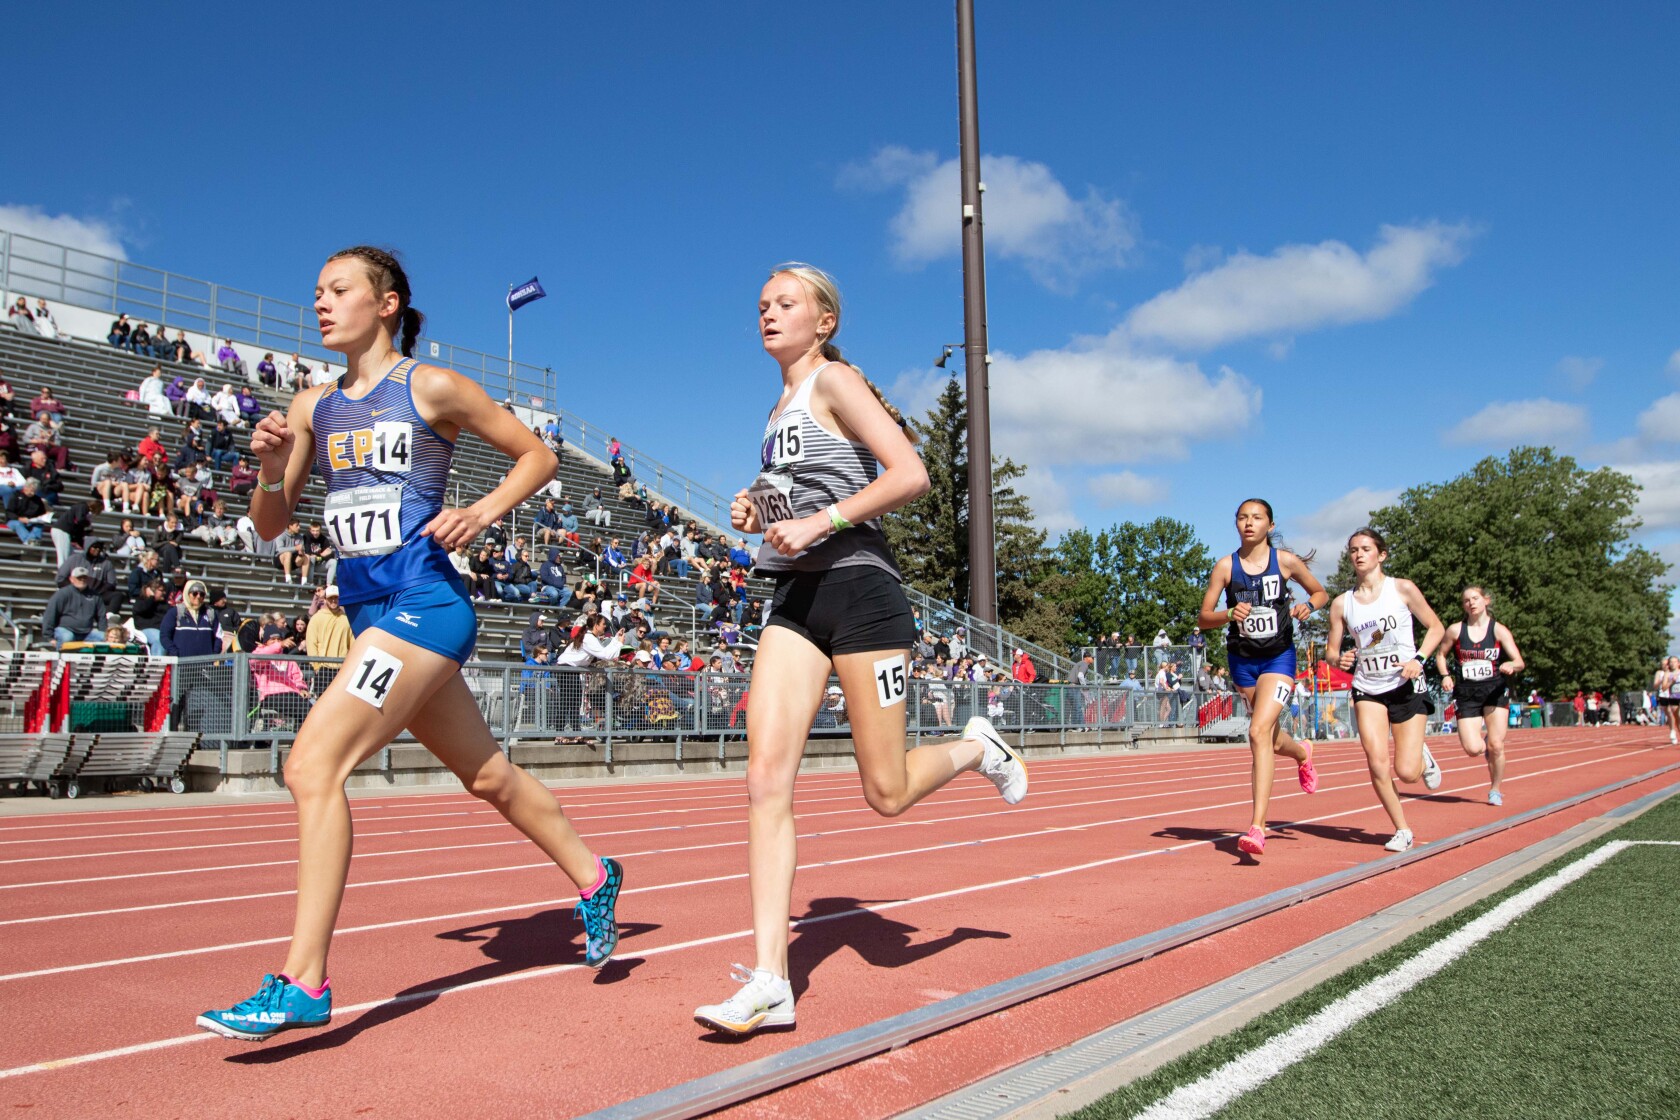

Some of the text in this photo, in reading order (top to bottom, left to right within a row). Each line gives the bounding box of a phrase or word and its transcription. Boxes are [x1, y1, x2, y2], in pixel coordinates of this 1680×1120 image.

[432, 345, 437, 353] G
[375, 431, 407, 464] 14
[777, 425, 800, 458] 15
[753, 493, 793, 523] 1263
[329, 508, 392, 547] 1171
[1265, 580, 1278, 596] 17
[1379, 615, 1396, 632] 20
[1363, 654, 1399, 671] 1179
[1485, 649, 1497, 659] 24
[356, 658, 395, 700] 14
[1465, 667, 1491, 678] 1145
[877, 665, 904, 698] 15
[1277, 685, 1290, 702] 17
